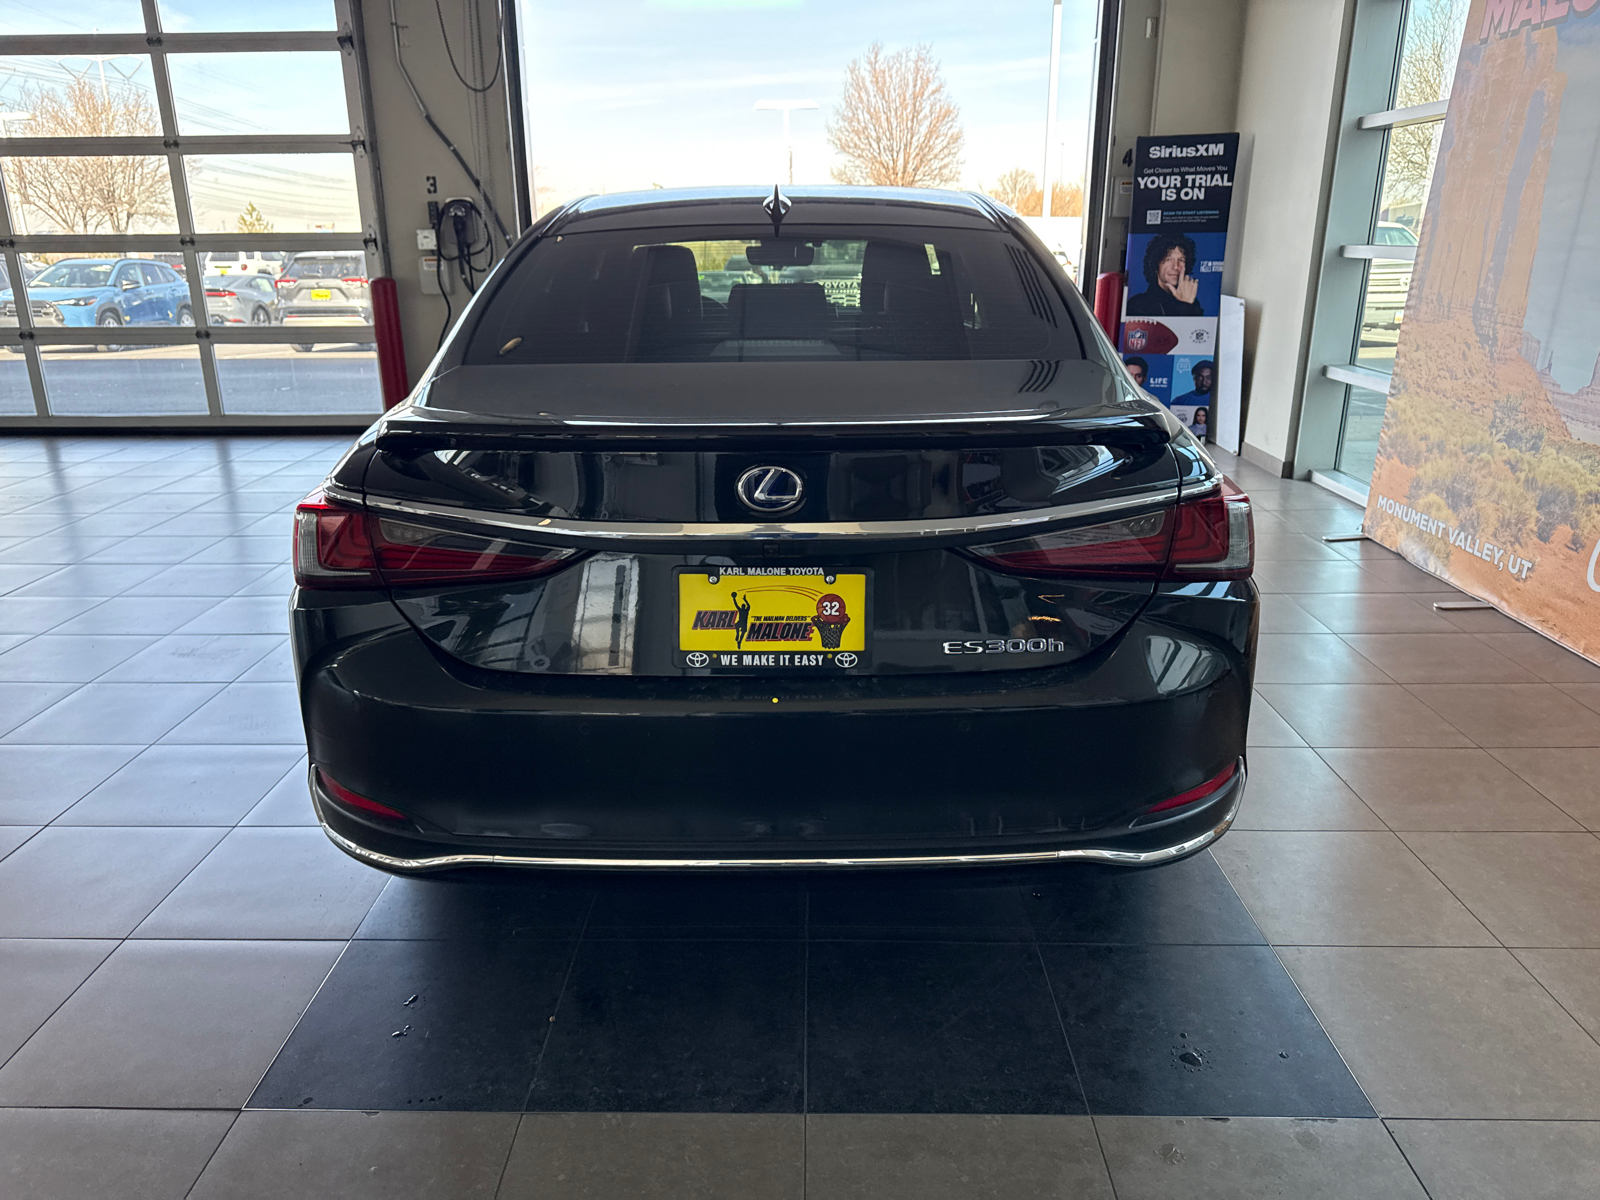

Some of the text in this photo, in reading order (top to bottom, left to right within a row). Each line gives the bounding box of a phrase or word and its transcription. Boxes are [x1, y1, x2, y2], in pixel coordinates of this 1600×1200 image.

[1122, 148, 1133, 167] 4
[1149, 143, 1224, 158] SiriusXM
[426, 176, 437, 194] 3
[1137, 175, 1181, 189] YOUR
[1185, 174, 1232, 187] TRIAL
[1161, 187, 1205, 201] IS ON
[1129, 338, 1146, 350] NFL
[1377, 494, 1532, 579] MONUMENT VALLEY, UT
[720, 567, 824, 576] KARL MALONE TOYOTA
[822, 601, 840, 616] 32
[692, 610, 738, 630] KARL
[745, 622, 814, 641] MALONE
[942, 638, 1064, 654] ES300h
[720, 654, 824, 666] WE MAKE IT EASY
